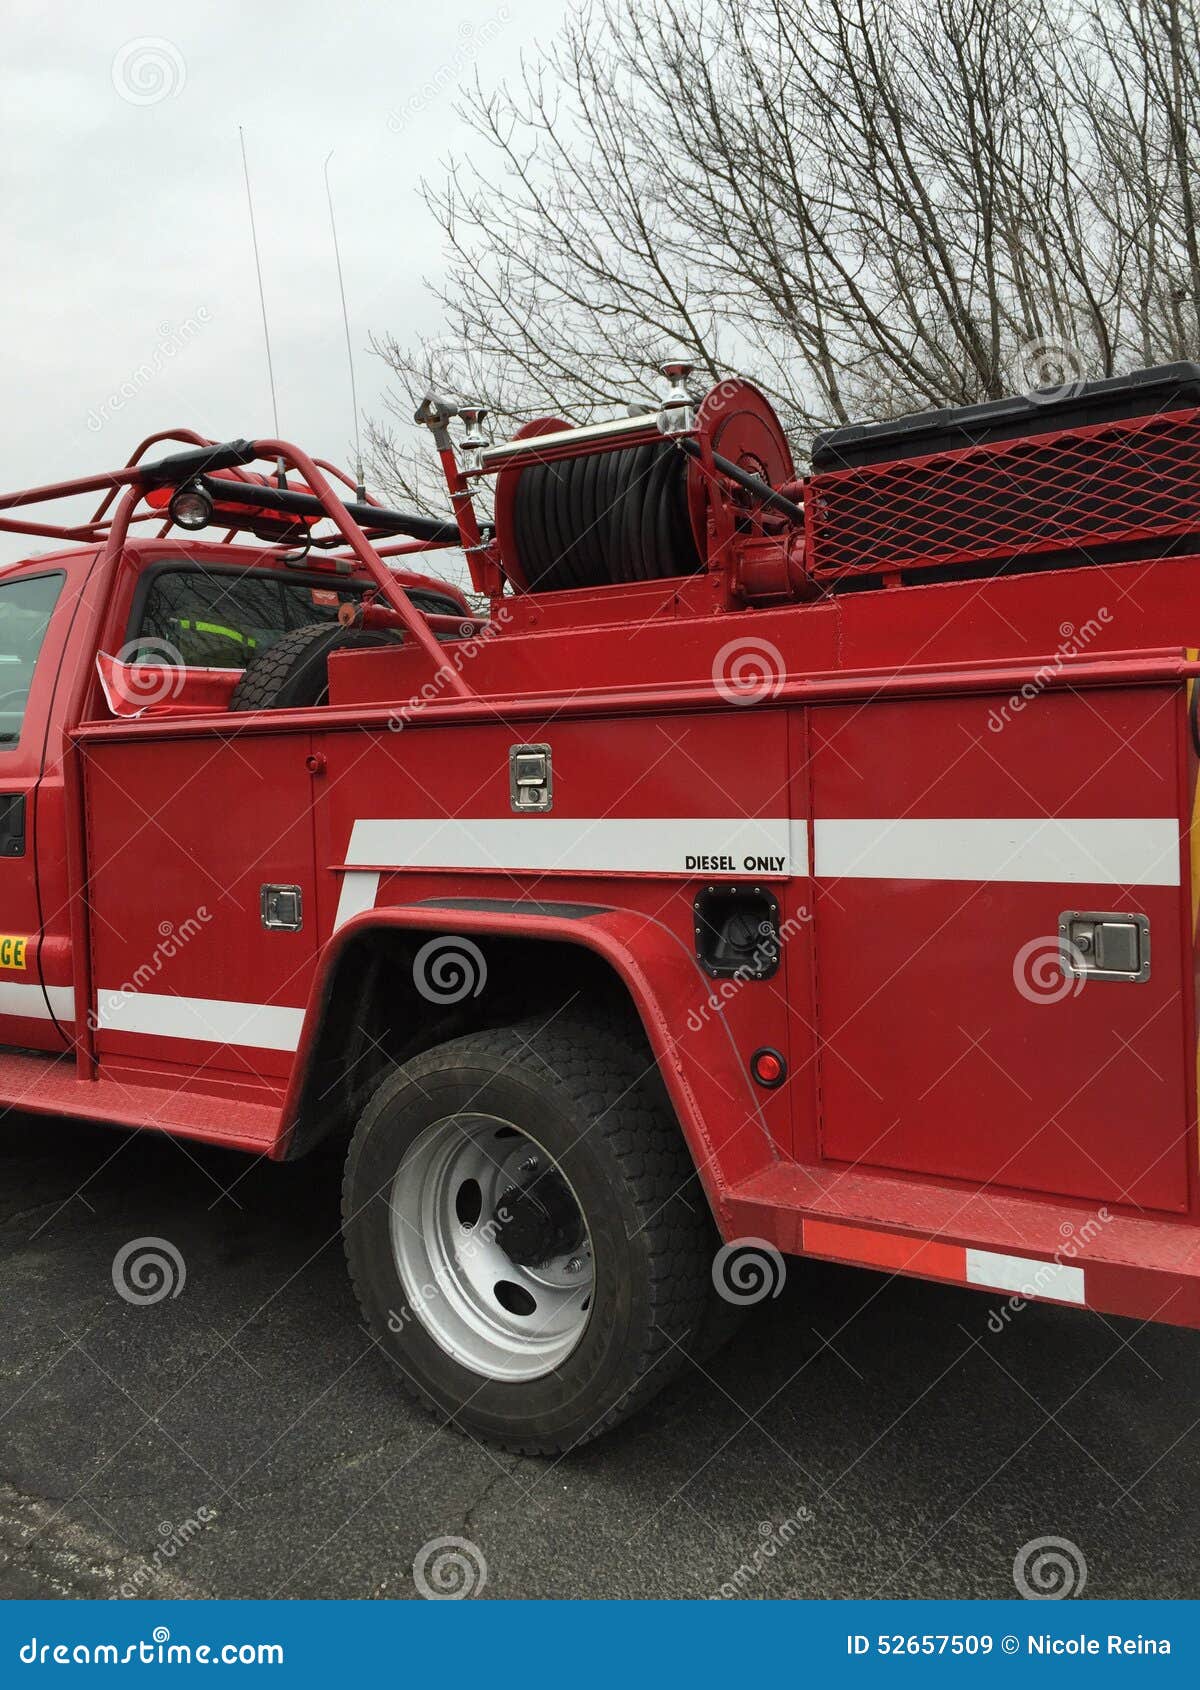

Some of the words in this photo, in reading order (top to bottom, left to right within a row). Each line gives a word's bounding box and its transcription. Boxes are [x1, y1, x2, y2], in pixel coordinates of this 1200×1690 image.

[685, 855, 736, 871] DIESEL
[743, 856, 786, 872] ONLY
[1, 939, 23, 967] CE
